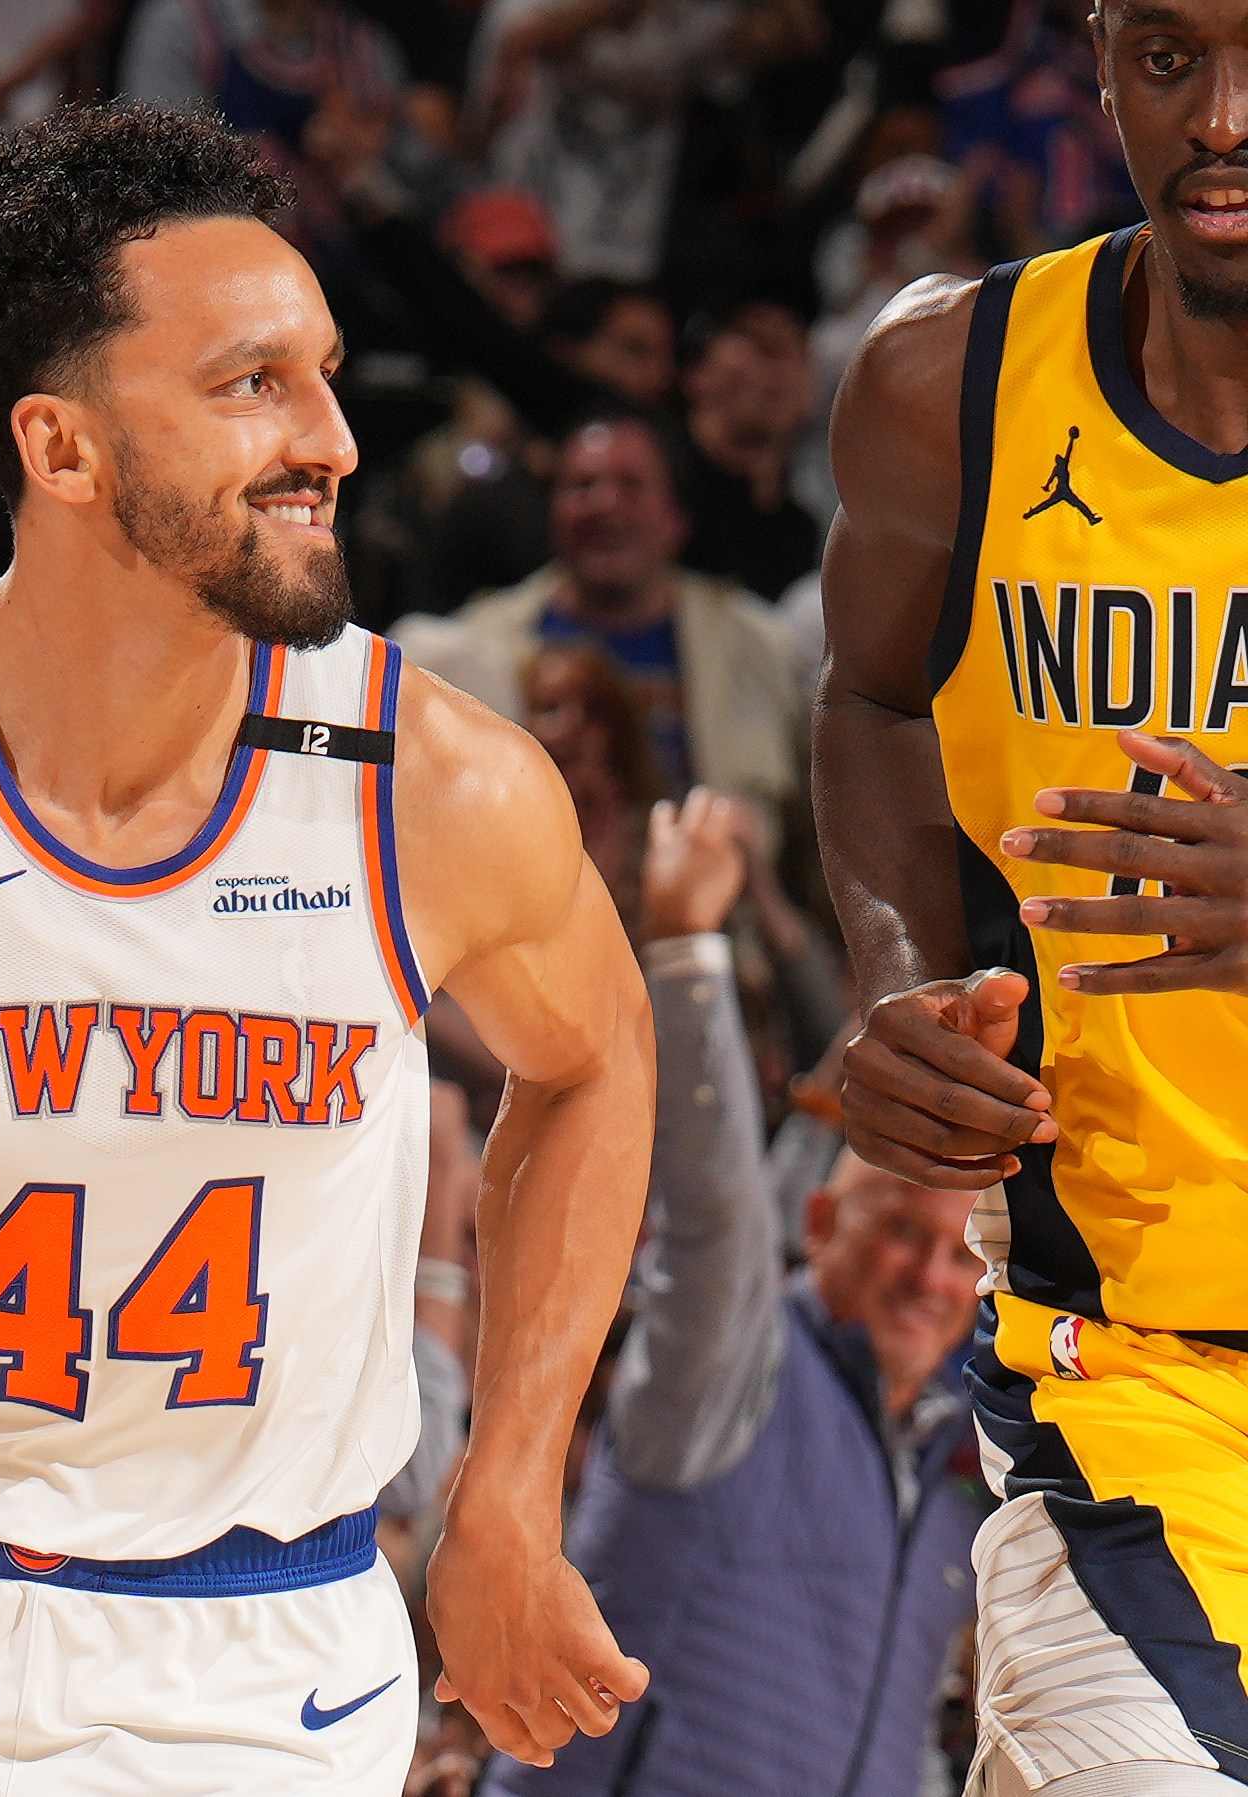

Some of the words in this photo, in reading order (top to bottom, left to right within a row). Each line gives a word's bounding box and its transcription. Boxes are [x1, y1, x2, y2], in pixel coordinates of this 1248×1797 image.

[990, 577, 1248, 733] INDIA
[301, 724, 331, 755] 12
[215, 875, 290, 889] experience
[213, 888, 267, 913] abu
[108, 1004, 379, 1128] YORK
